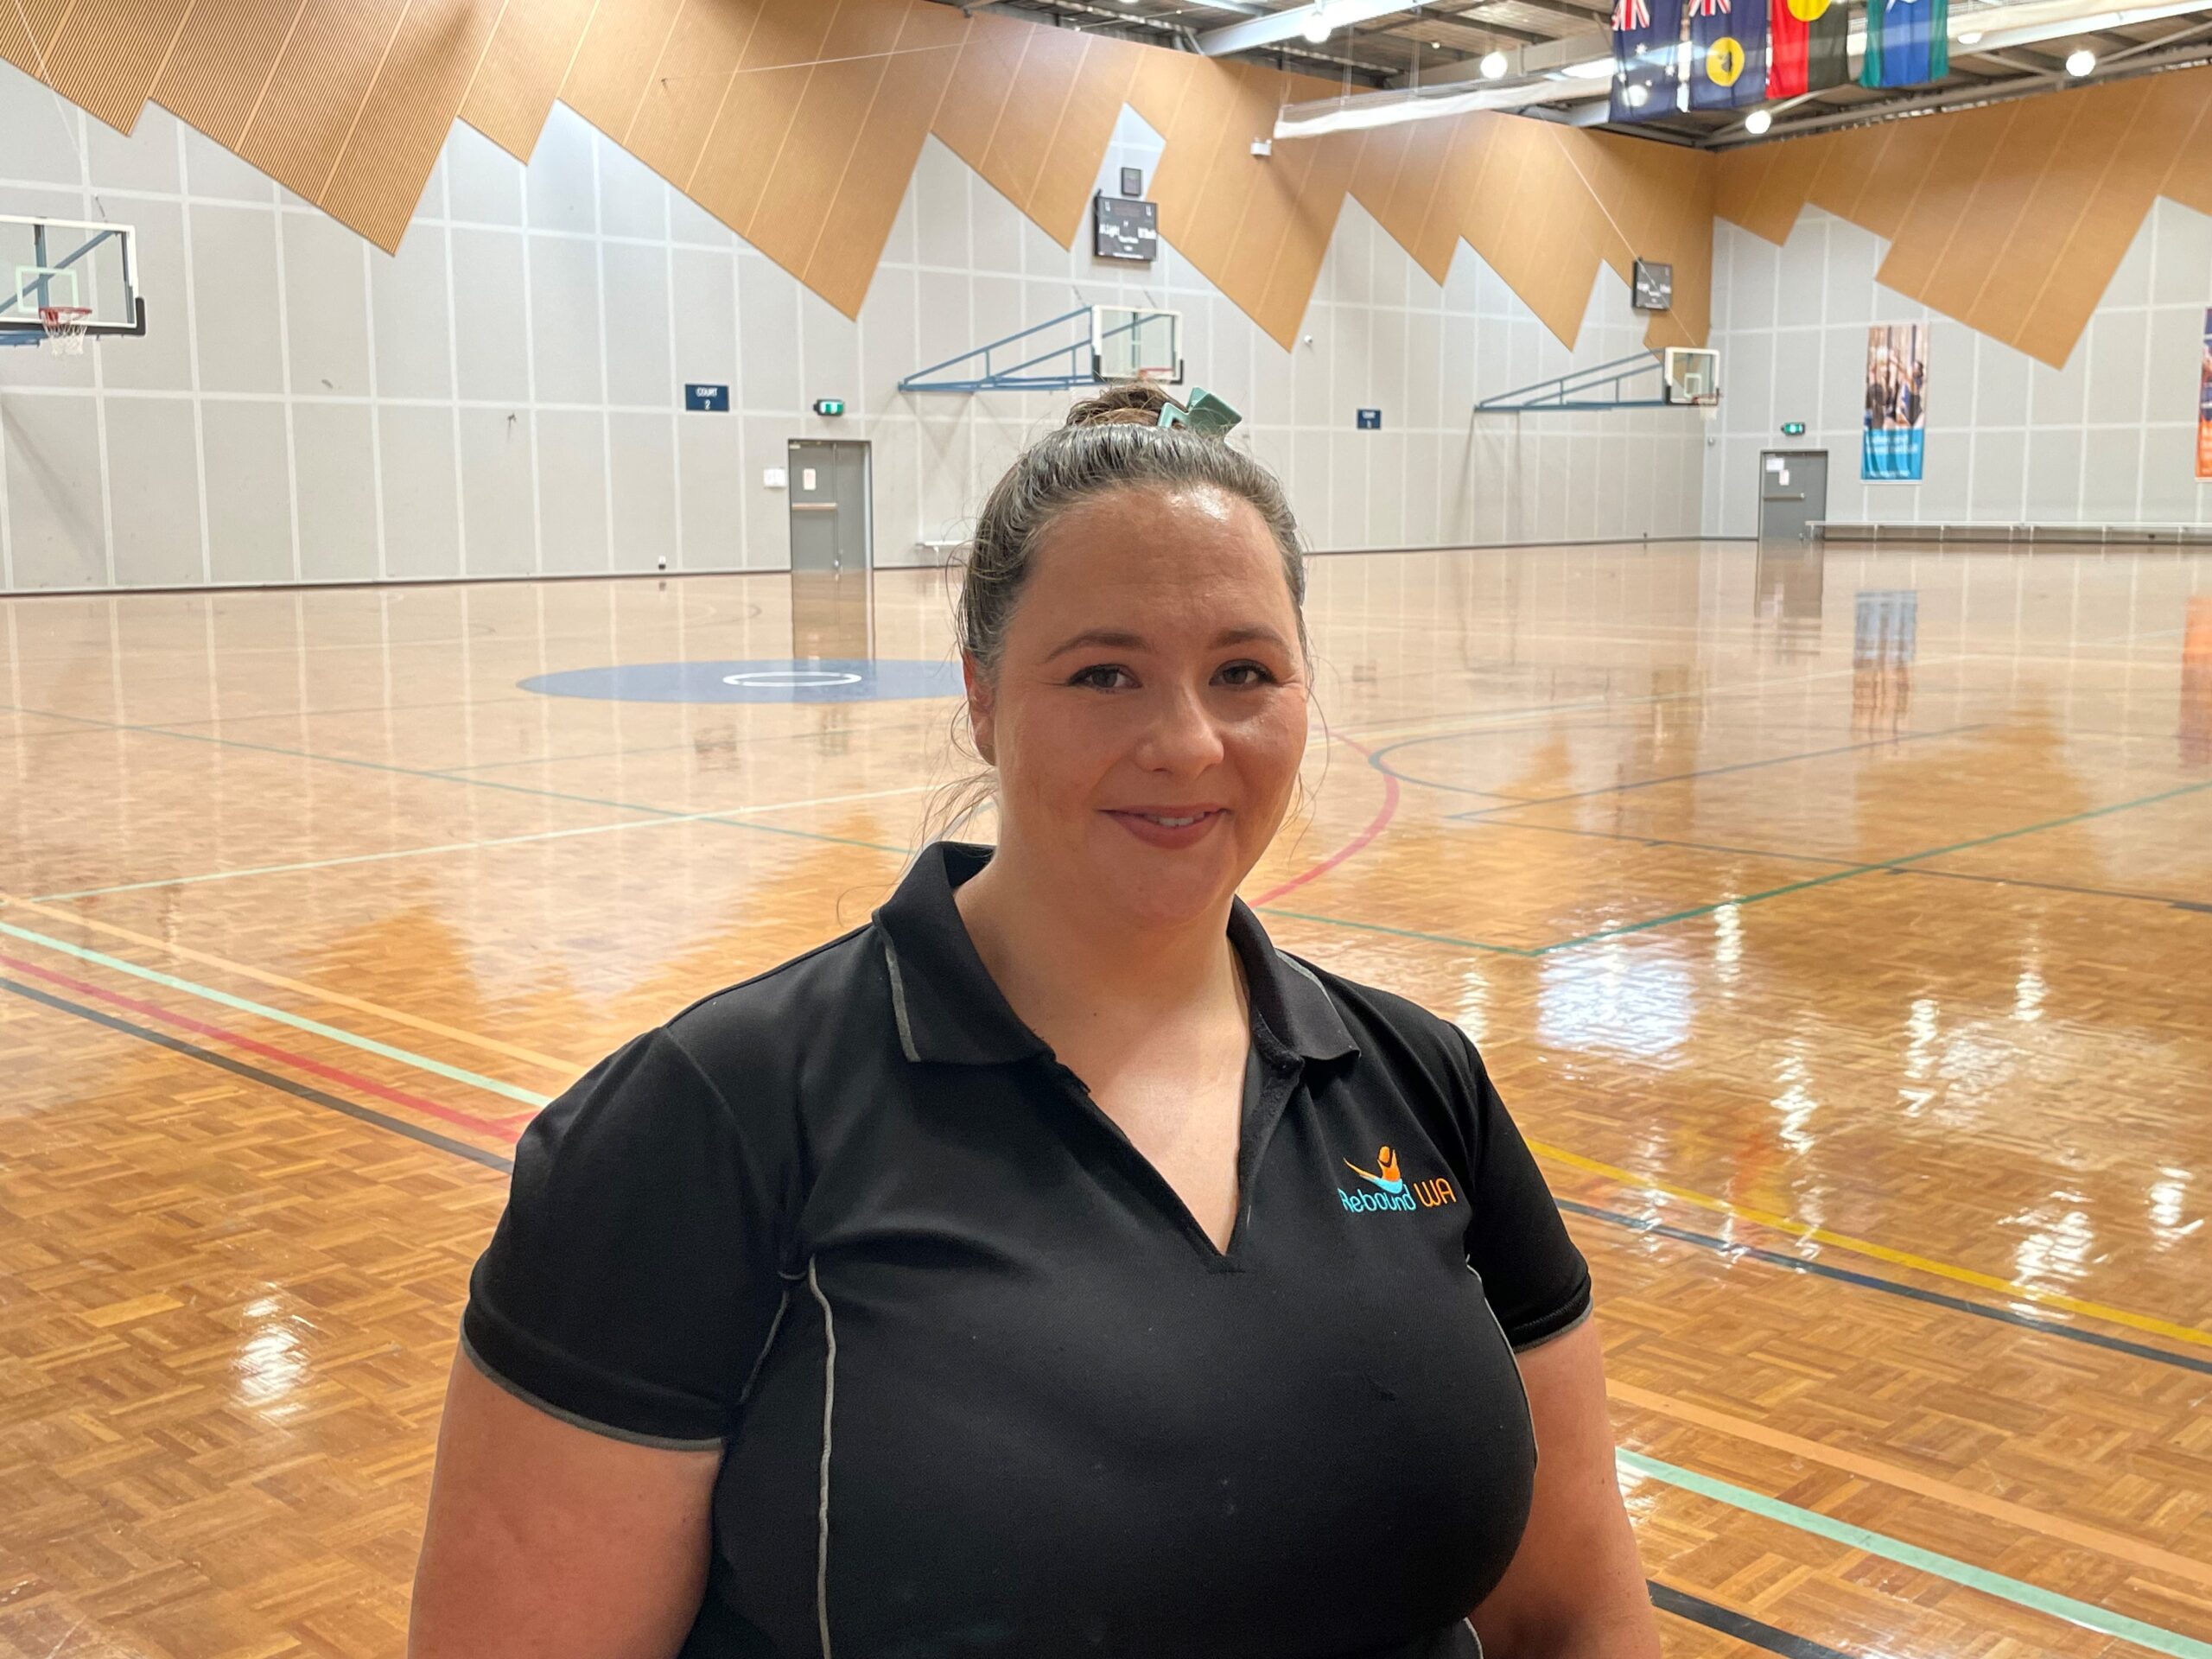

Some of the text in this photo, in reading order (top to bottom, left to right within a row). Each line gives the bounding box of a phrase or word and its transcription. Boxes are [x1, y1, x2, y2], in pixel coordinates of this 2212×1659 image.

[696, 387, 718, 397] COURT
[704, 399, 711, 410] 2
[1338, 1178, 1457, 1212] Rebound WA
